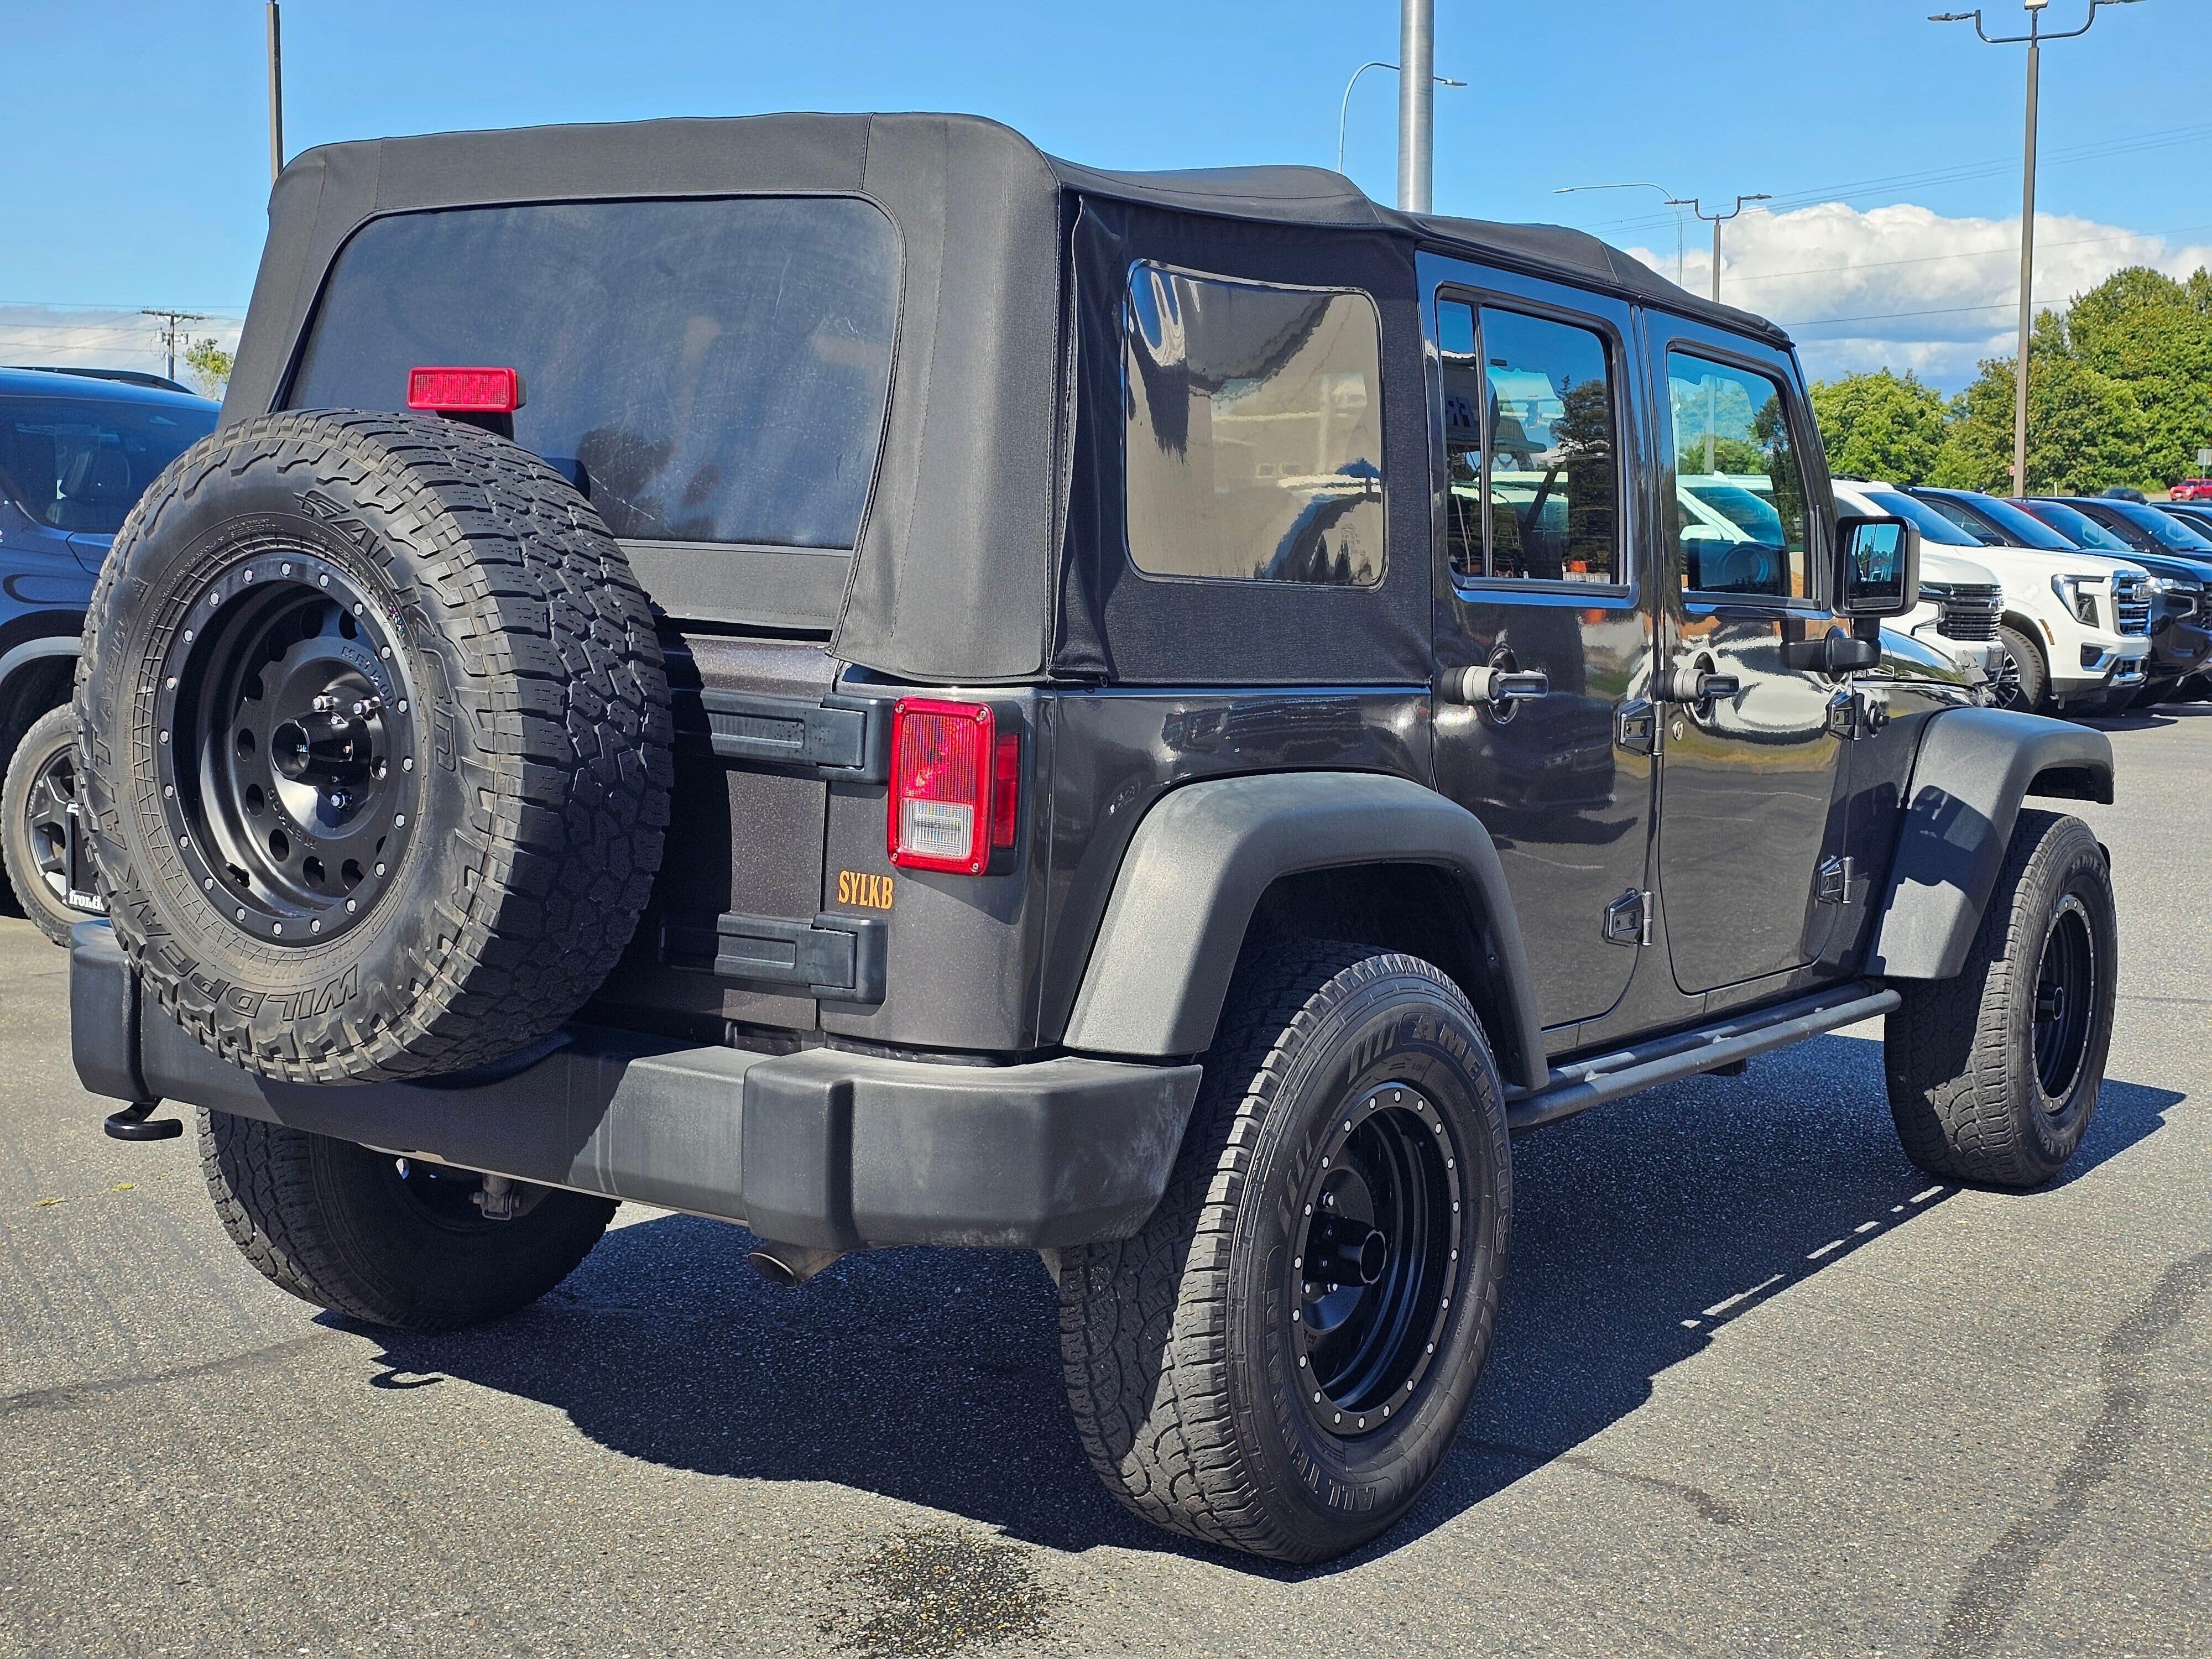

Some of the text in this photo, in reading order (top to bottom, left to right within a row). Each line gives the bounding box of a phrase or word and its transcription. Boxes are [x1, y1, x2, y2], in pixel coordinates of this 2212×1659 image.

[293, 489, 456, 772] FALKEN
[341, 646, 394, 709] METHOD
[113, 863, 358, 1021] WILDPEAK
[838, 870, 894, 909] SYLKB
[1412, 1015, 1510, 1254] AMERICUS
[1266, 1289, 1319, 1494] TERRAIN
[1328, 1478, 1376, 1511] ALL
